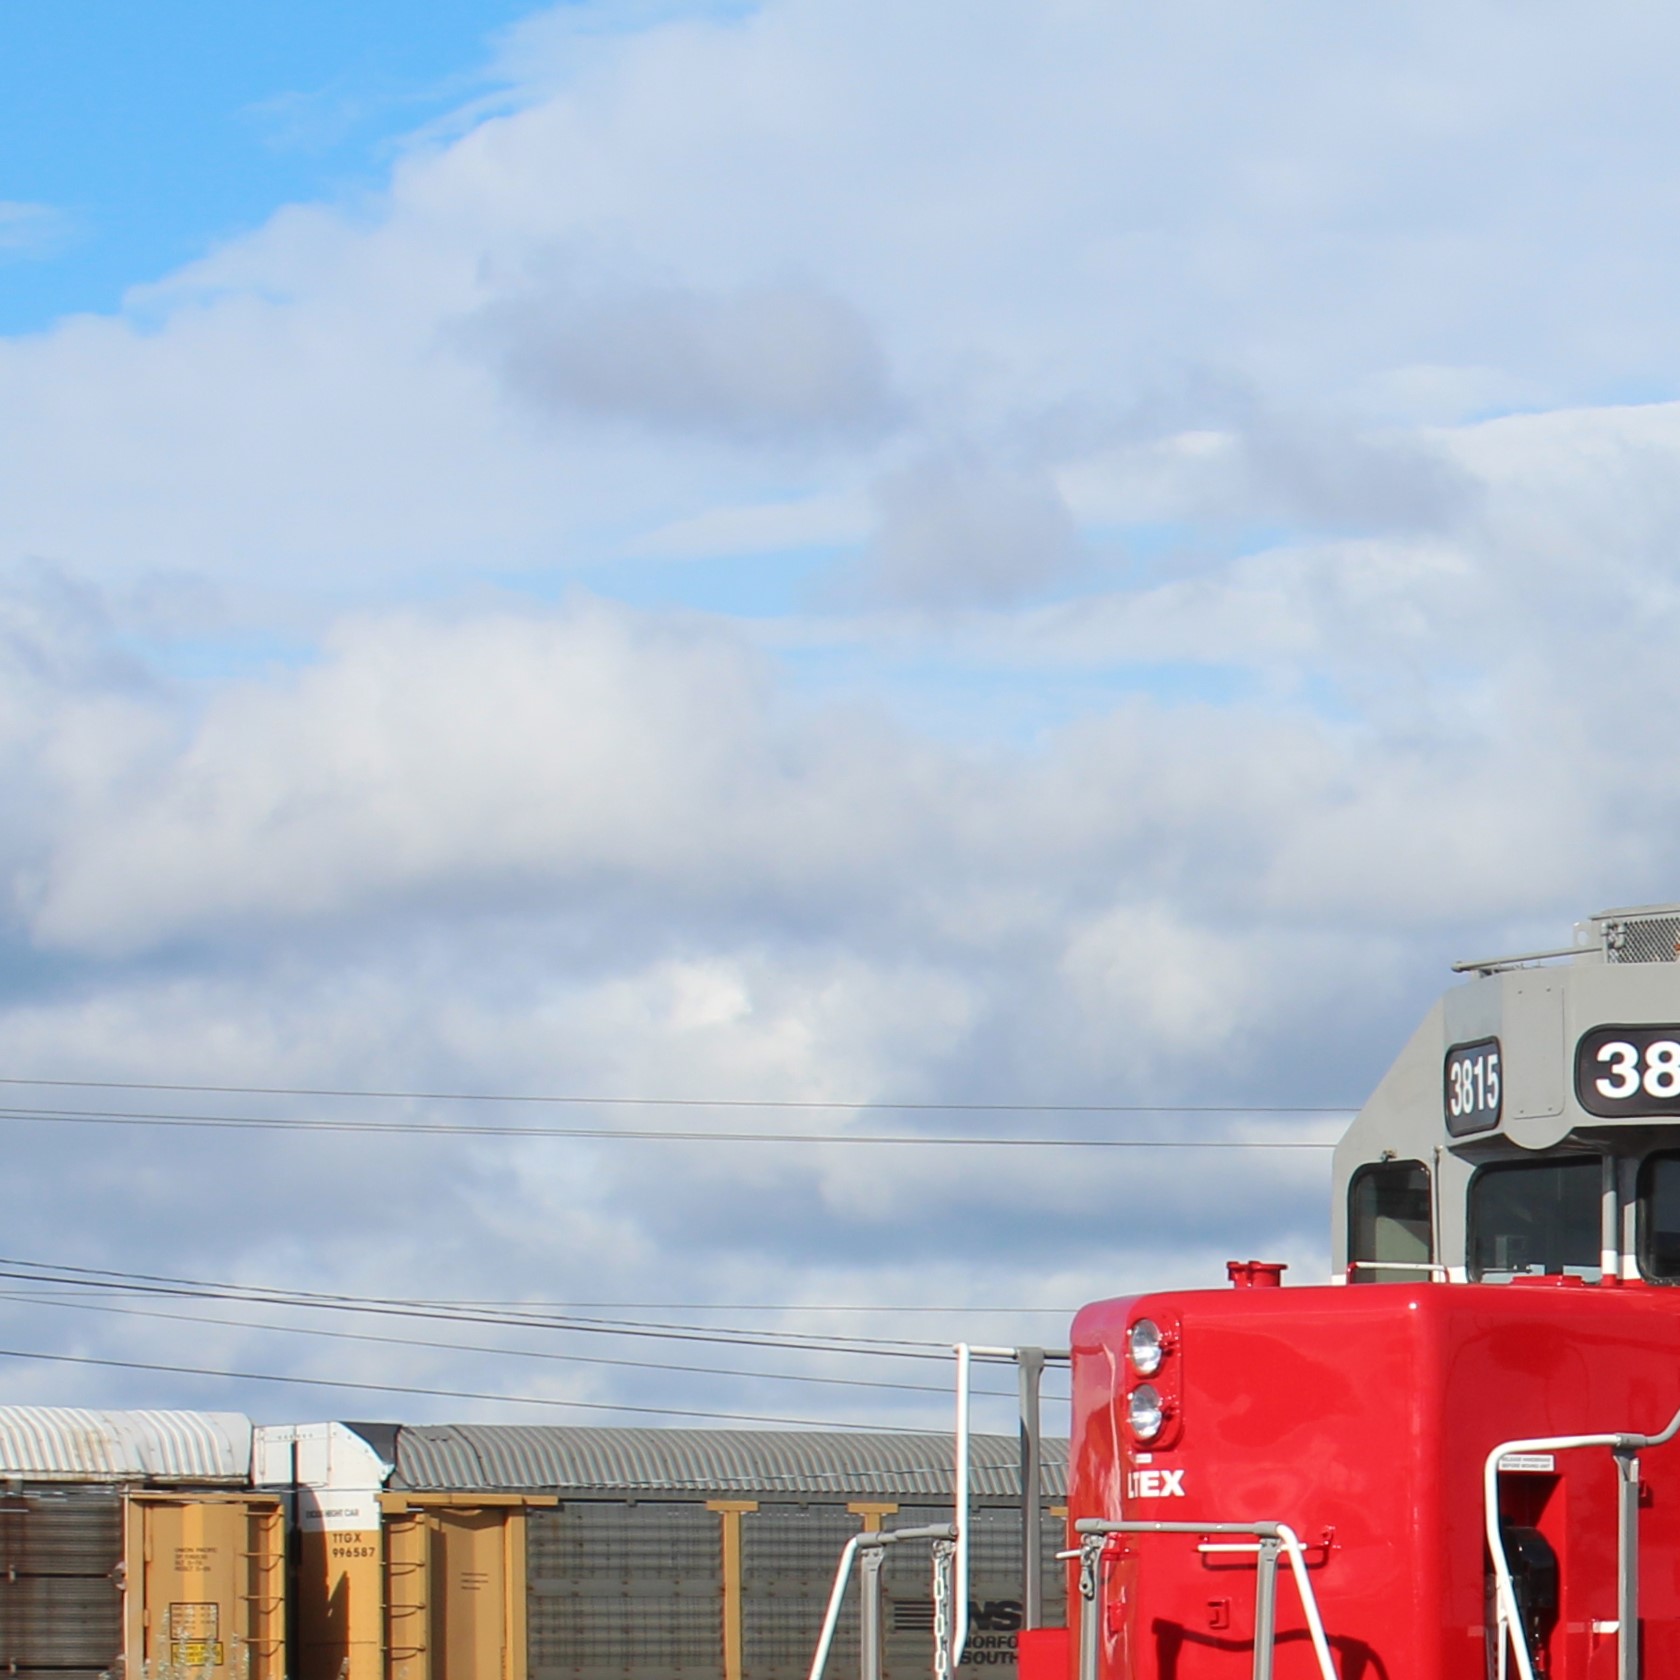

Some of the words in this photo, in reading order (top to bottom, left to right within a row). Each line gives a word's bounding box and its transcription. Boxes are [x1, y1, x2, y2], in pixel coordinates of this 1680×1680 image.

[1450, 1053, 1498, 1117] 3815
[1127, 1469, 1186, 1499] LTEX
[332, 1547, 375, 1557] 996587
